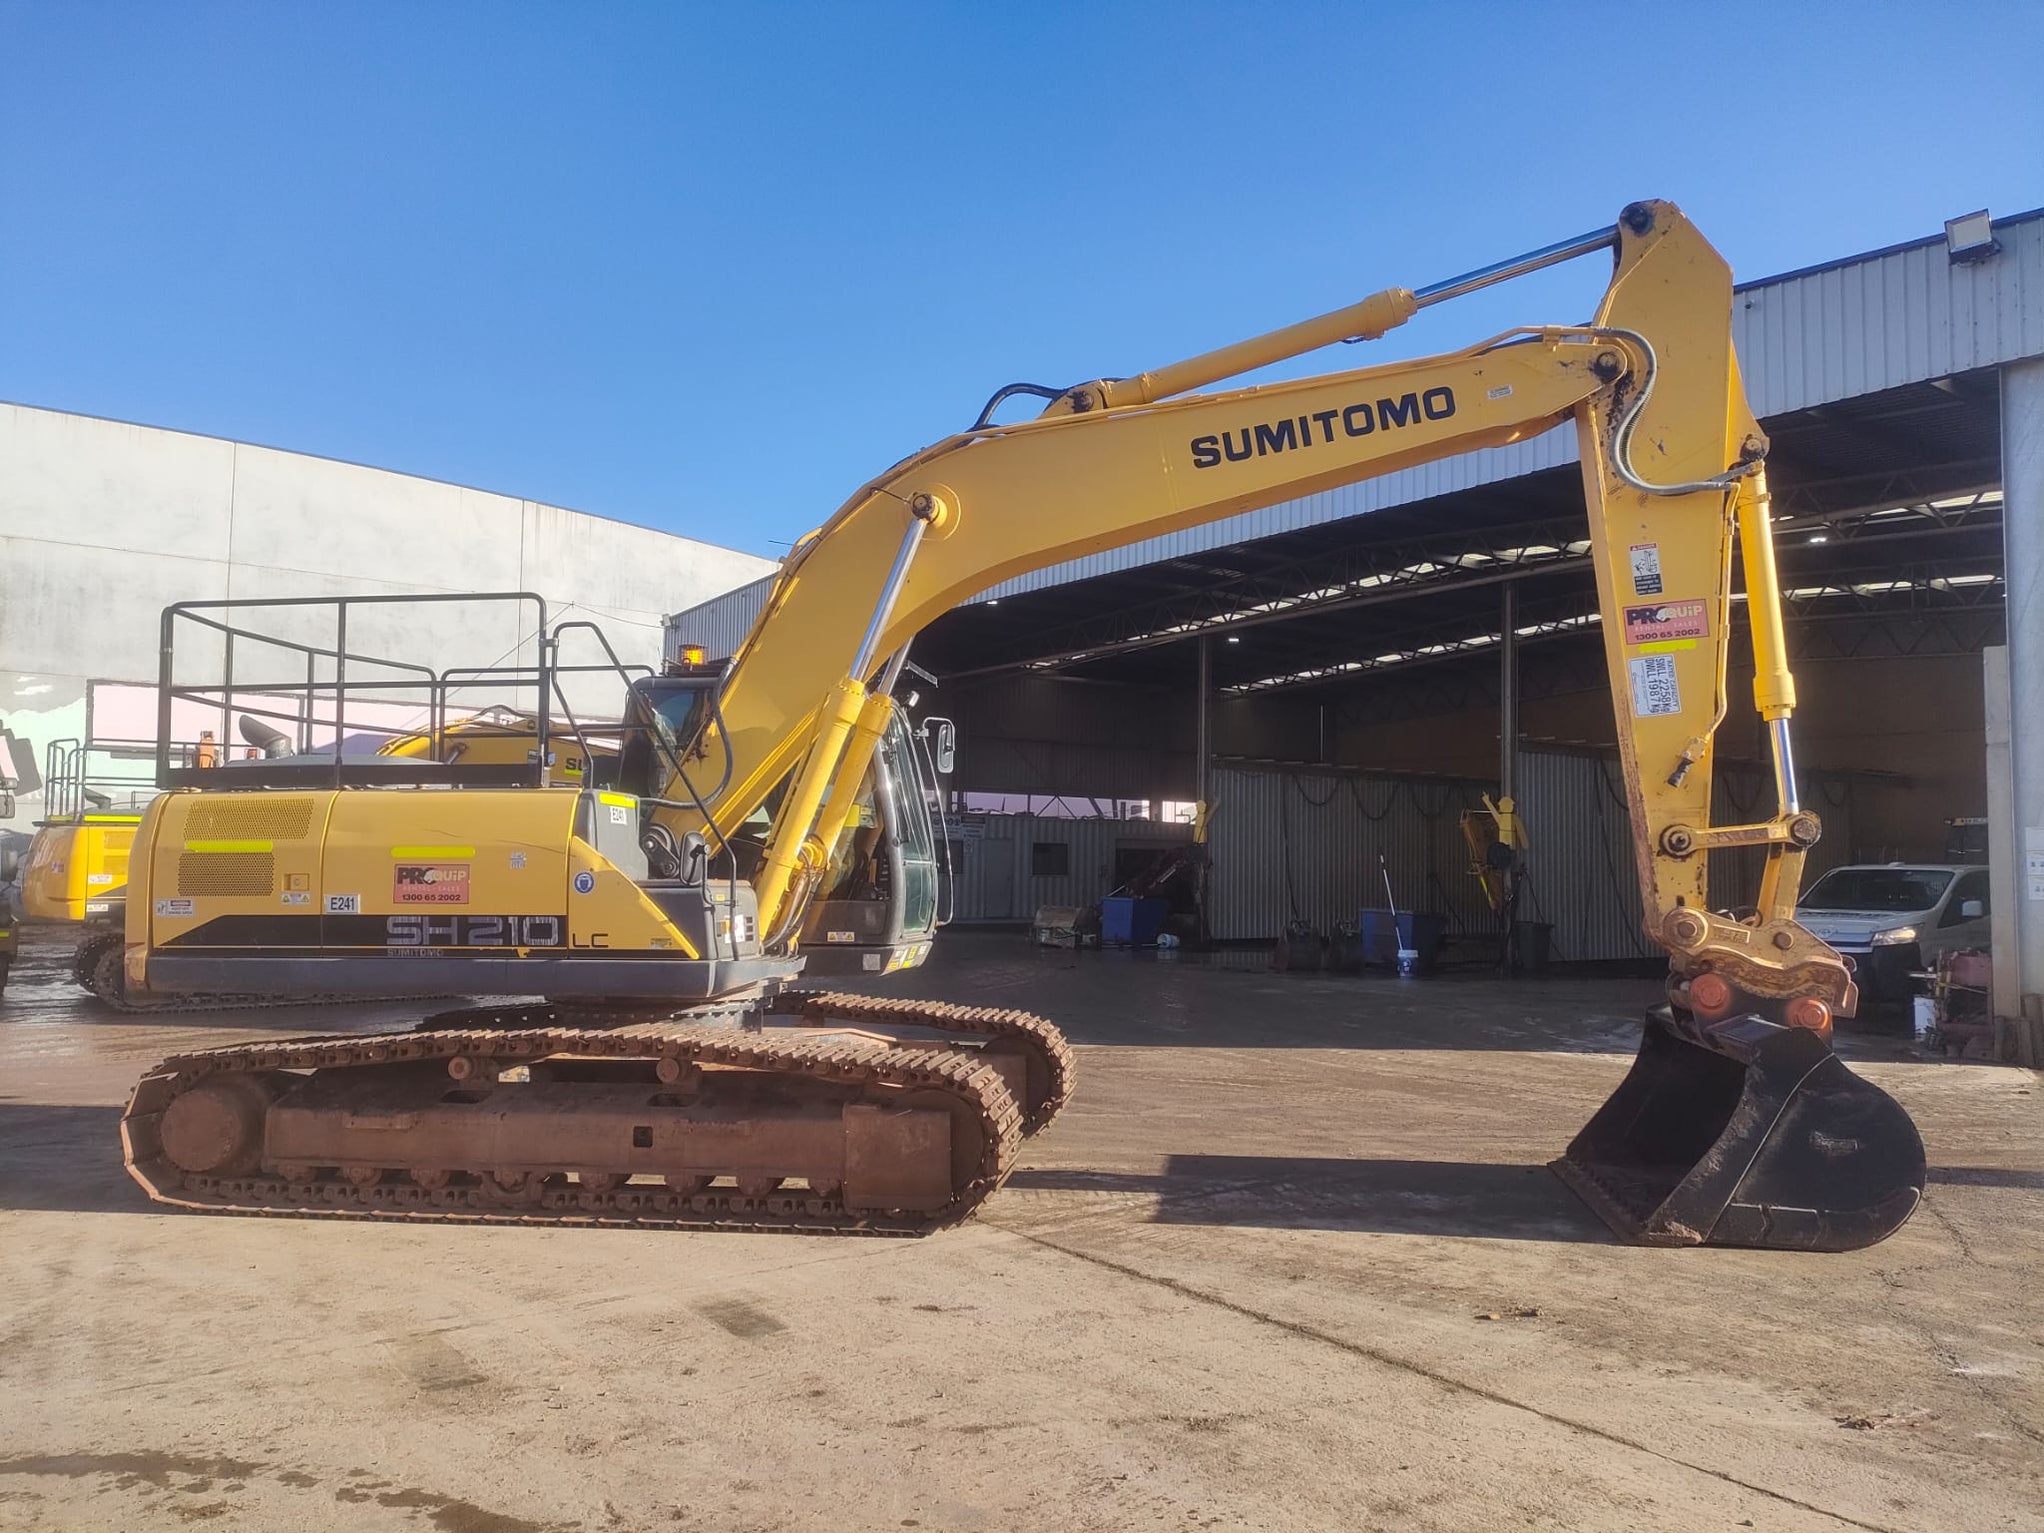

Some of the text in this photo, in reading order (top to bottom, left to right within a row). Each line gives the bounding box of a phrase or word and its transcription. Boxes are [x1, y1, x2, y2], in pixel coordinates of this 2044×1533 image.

[1190, 386, 1456, 469] SUMITOMO
[1635, 628, 1700, 641] 1300 65 2002
[1645, 659, 1657, 678] DWLL
[1655, 658, 1667, 677] SWLL
[330, 897, 354, 910] E241
[572, 933, 608, 947] LC
